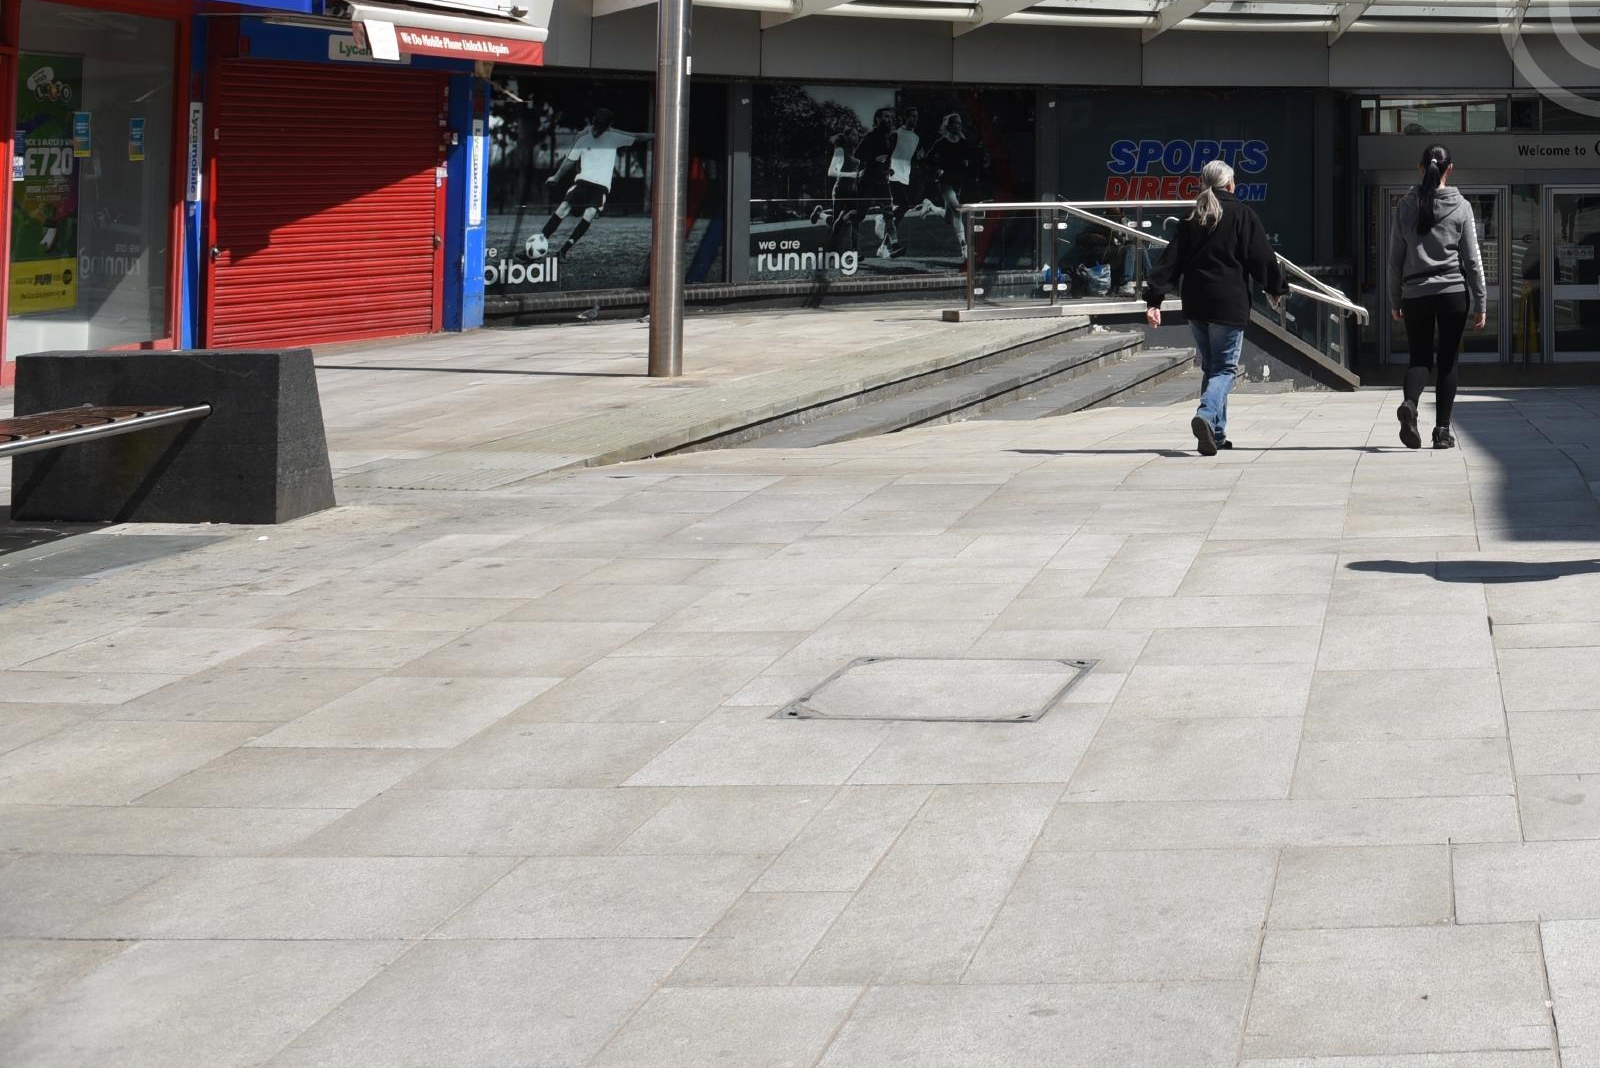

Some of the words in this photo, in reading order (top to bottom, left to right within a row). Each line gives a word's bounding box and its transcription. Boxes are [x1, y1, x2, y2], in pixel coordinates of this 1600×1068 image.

[411, 33, 422, 45] Do
[422, 35, 443, 48] Mobile
[443, 37, 462, 50] Phone
[190, 109, 200, 194] Lycamobile
[1106, 139, 1269, 174] SPORTS
[1518, 144, 1570, 156] Welcome
[1575, 145, 1587, 156] to
[759, 240, 776, 250] we
[780, 239, 800, 249] are
[484, 256, 558, 285] otball
[758, 247, 858, 275] running
